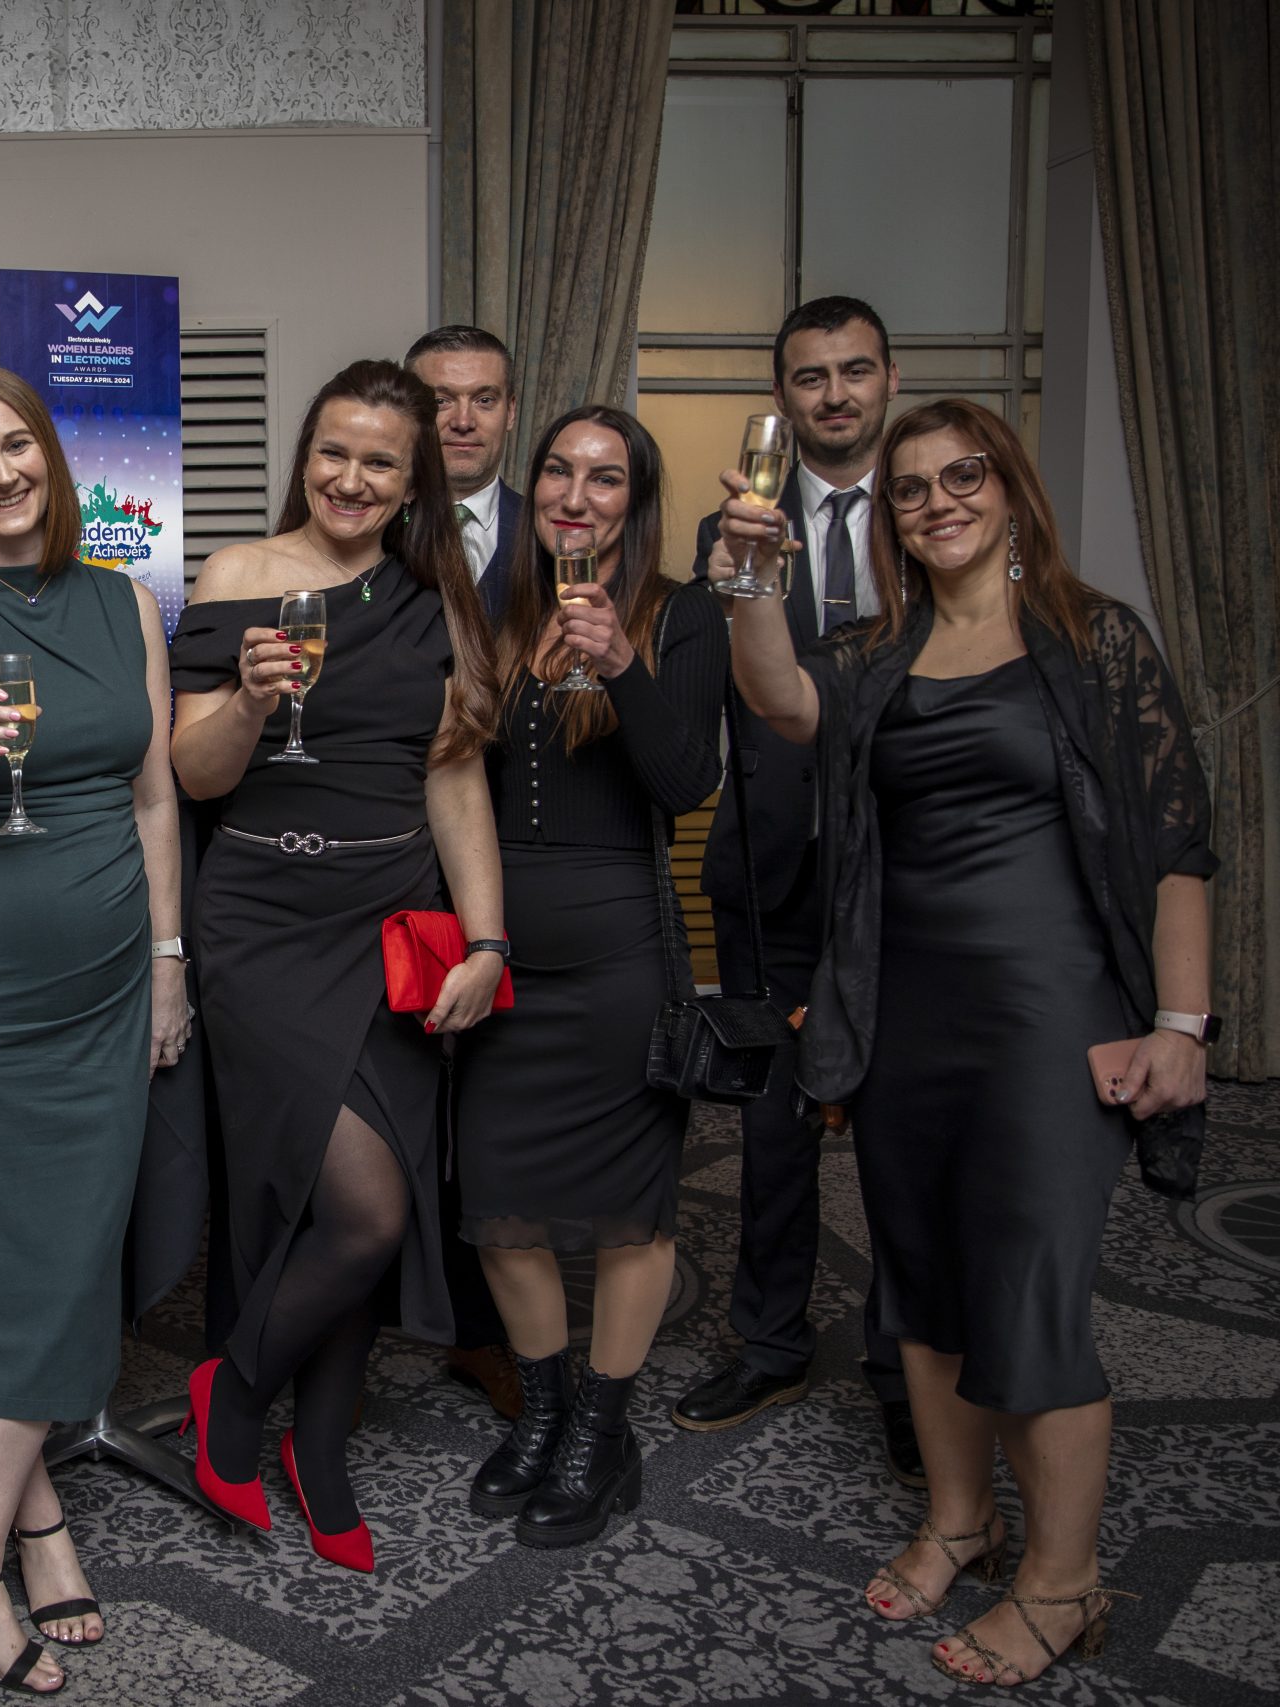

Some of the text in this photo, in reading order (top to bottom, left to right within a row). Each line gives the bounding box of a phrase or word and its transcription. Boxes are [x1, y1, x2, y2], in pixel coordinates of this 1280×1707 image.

[48, 344, 134, 355] WOMEN LEADERS
[51, 354, 131, 365] IN ELECTRONICS
[52, 375, 83, 383] TUESDAY
[92, 545, 148, 558] Achievers
